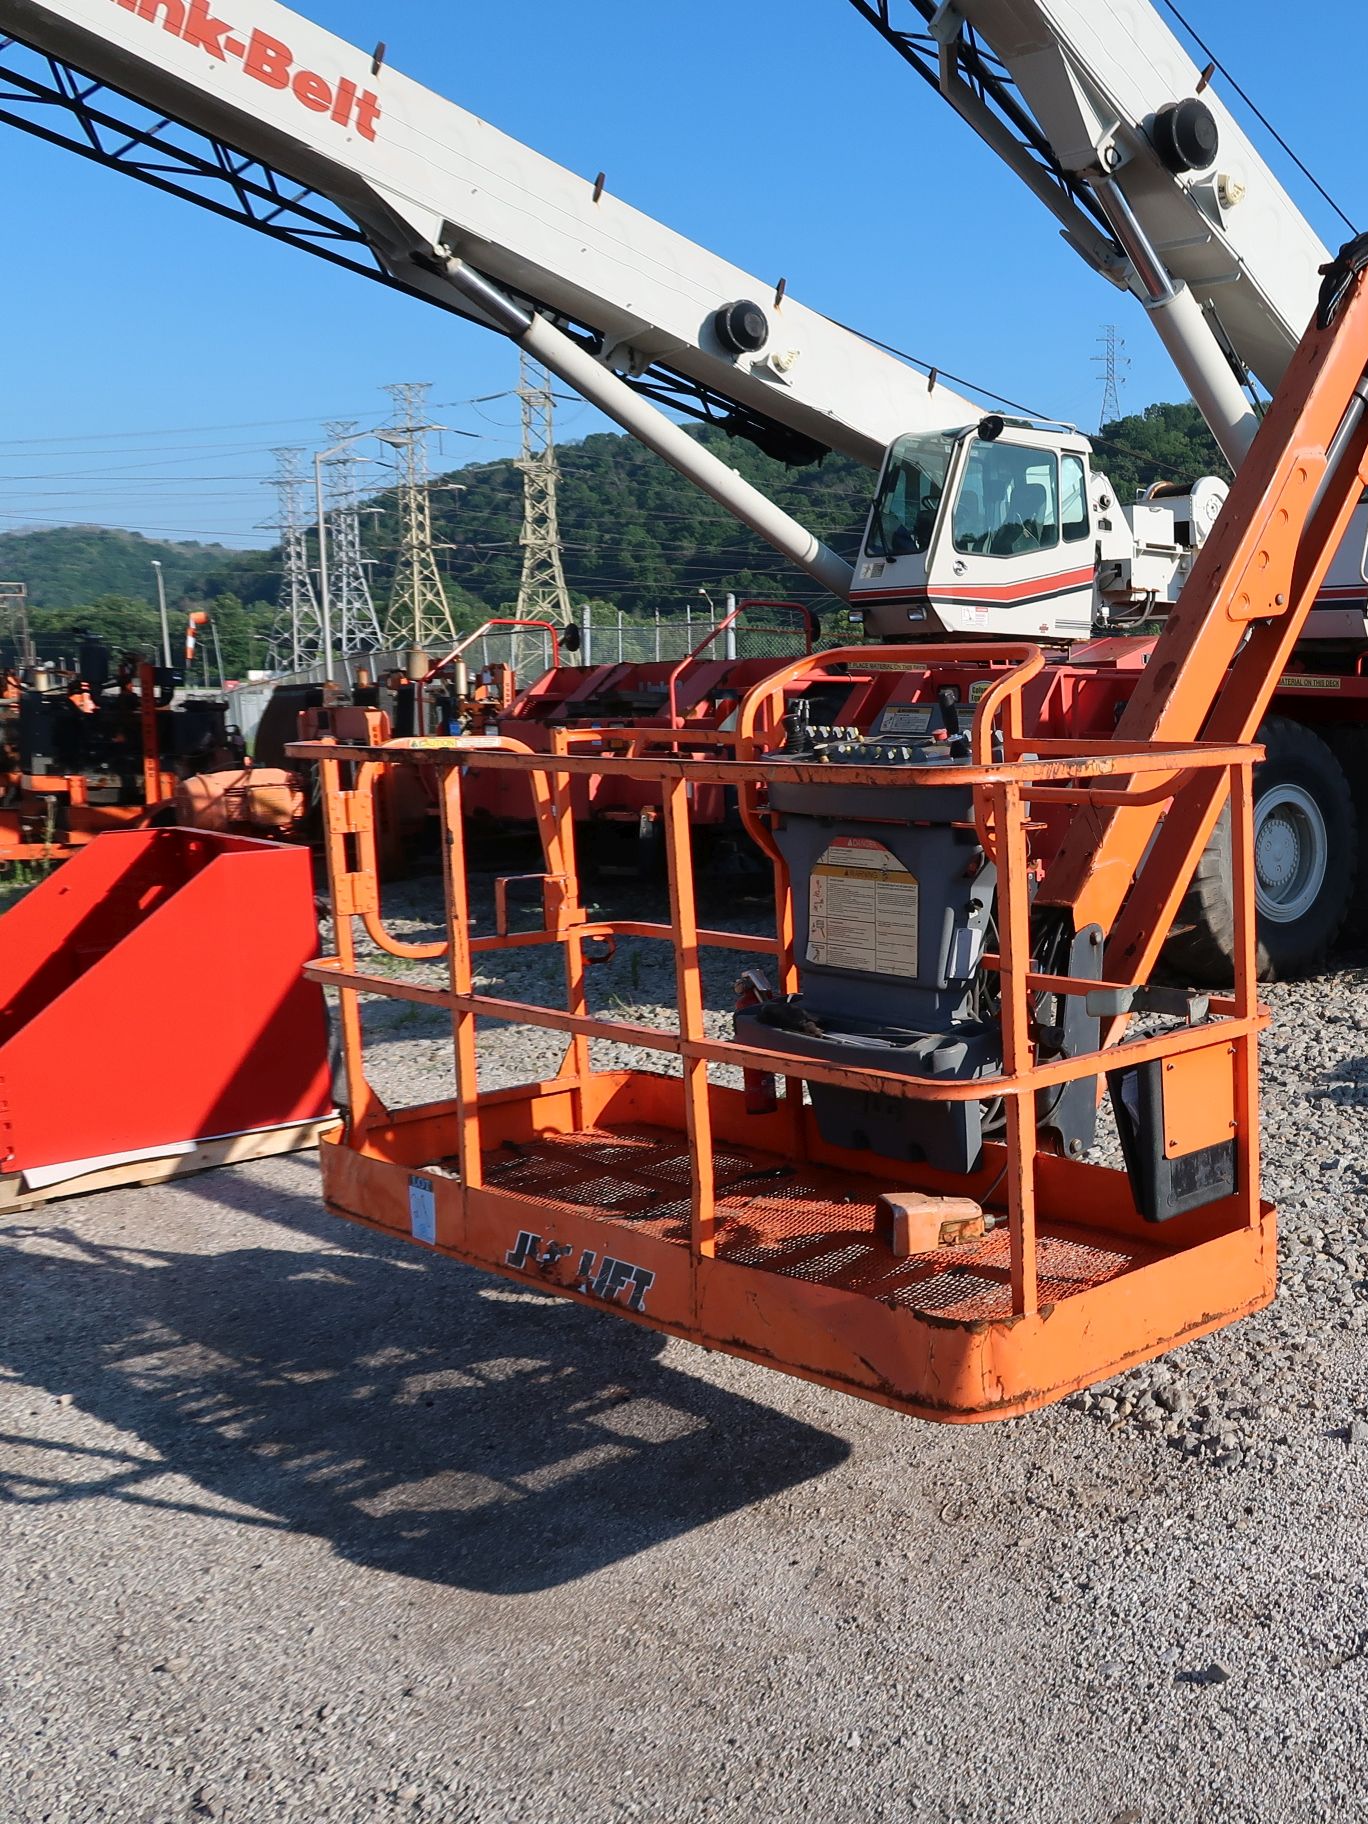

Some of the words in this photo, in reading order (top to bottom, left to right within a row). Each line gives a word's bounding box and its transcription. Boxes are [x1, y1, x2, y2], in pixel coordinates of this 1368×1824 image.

[109, 0, 382, 142] nk-Belt
[1280, 678, 1302, 686] ATERIAL
[1303, 679, 1312, 687] ON
[1326, 680, 1340, 688] DECK
[411, 1175, 433, 1192] LOT
